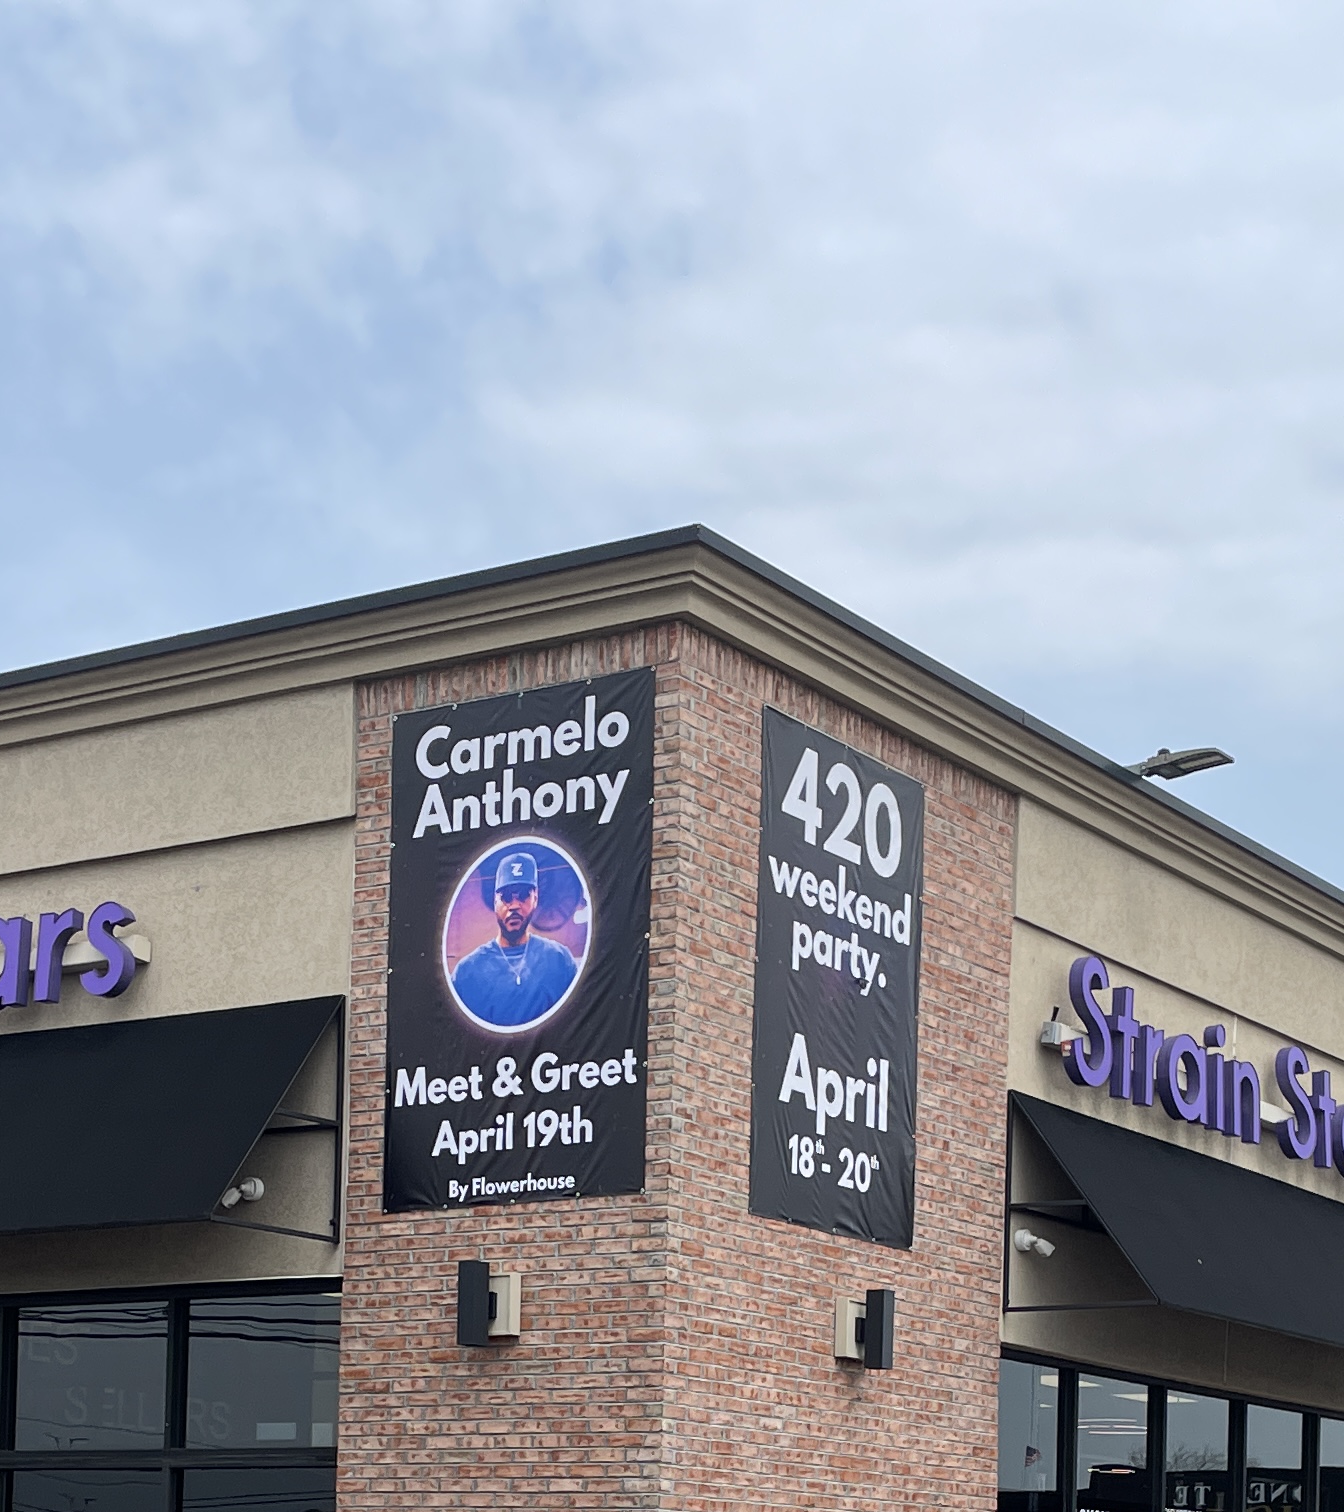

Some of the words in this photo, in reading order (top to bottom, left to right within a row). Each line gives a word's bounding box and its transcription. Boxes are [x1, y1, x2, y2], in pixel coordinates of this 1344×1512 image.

[415, 695, 630, 780] Carmelo
[412, 768, 630, 839] Anthony
[781, 747, 902, 878] 420
[768, 855, 911, 946] weekend
[394, 1065, 483, 1108] Meet
[492, 1056, 523, 1096] &
[531, 1049, 638, 1094] Greet
[778, 1032, 890, 1136] April
[1063, 956, 1261, 1144] Strain
[431, 1114, 515, 1164] April
[522, 1106, 593, 1146] 19th
[448, 1179, 468, 1201] By
[472, 1172, 575, 1195] Flowerhouse
